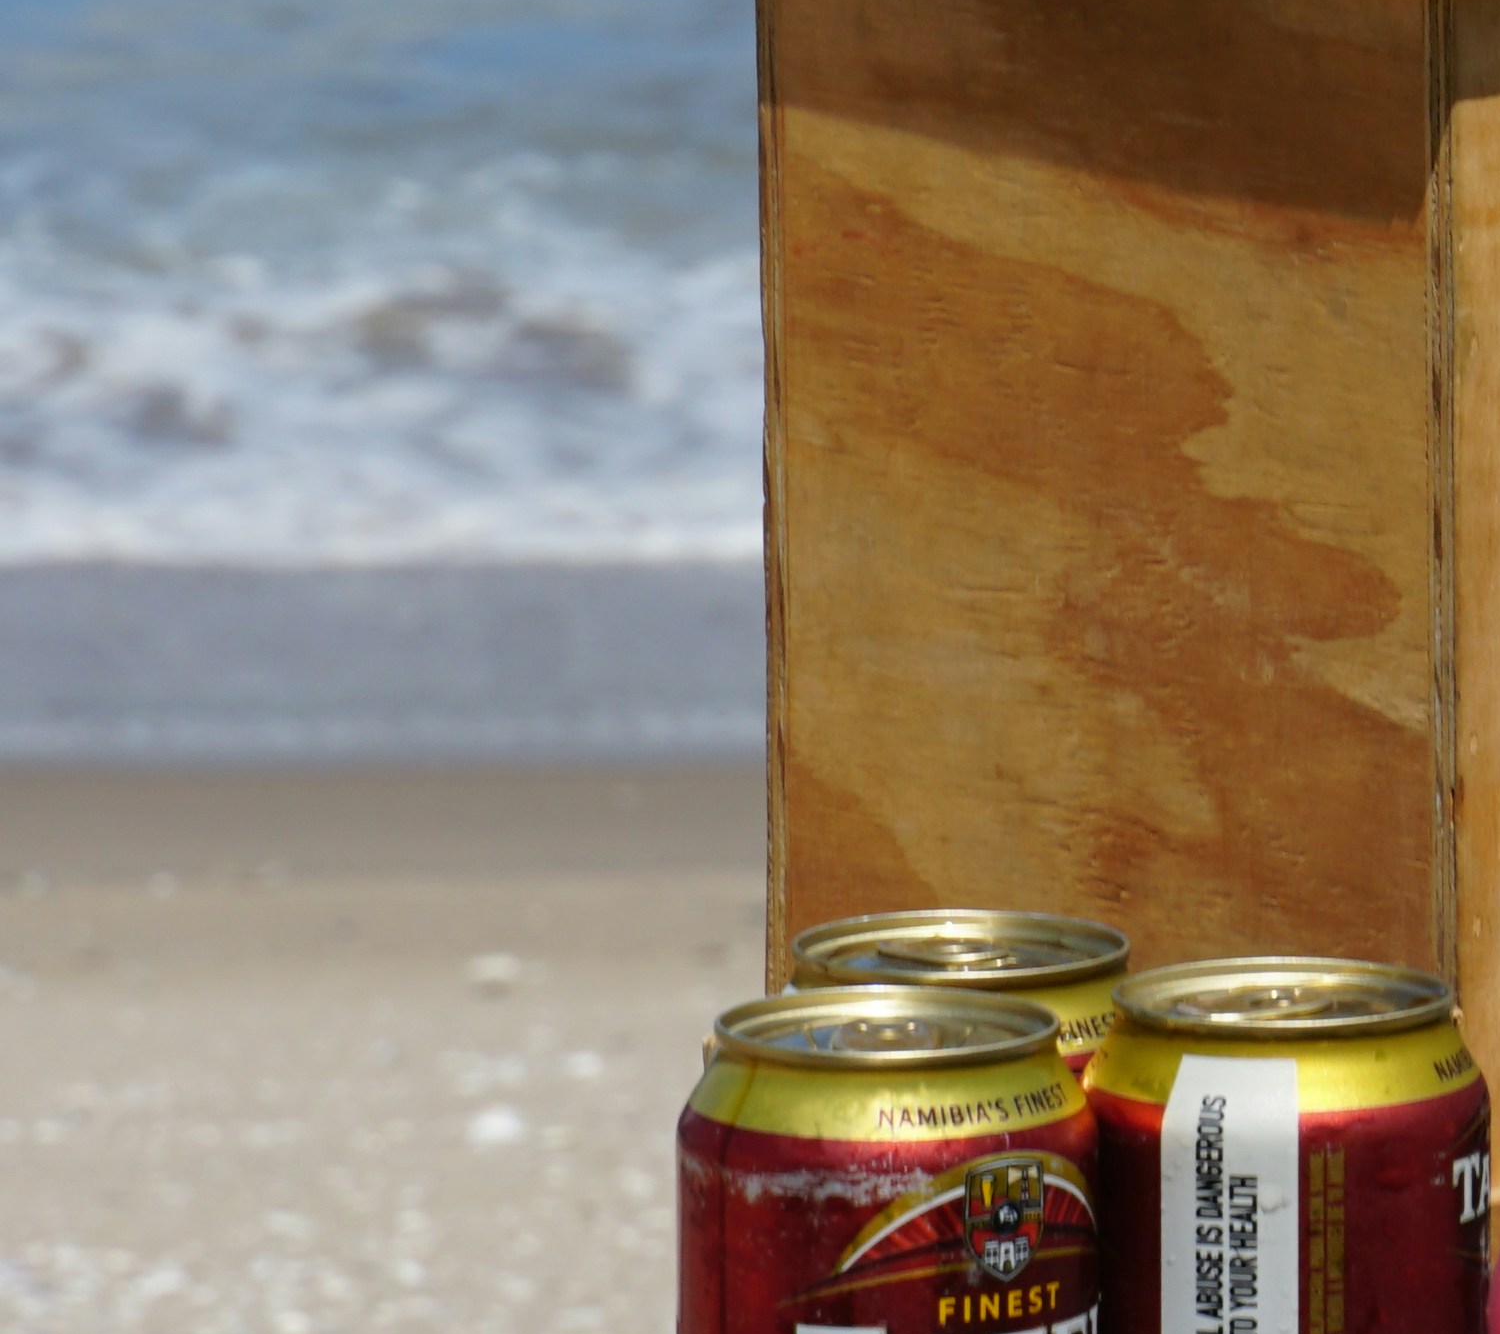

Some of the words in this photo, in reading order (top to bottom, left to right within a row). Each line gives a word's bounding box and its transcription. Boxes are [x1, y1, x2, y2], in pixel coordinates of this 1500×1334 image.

[879, 1097, 1009, 1129] NAMIBIA'S
[1013, 1081, 1069, 1117] FINEST
[1196, 1094, 1227, 1219] DANGEROUS
[1196, 1224, 1224, 1247] IS
[1229, 1174, 1258, 1251] HEALTH
[938, 1281, 1060, 1326] FINEST
[1196, 1248, 1224, 1319] ABUSE
[1229, 1255, 1258, 1312] YOUR
